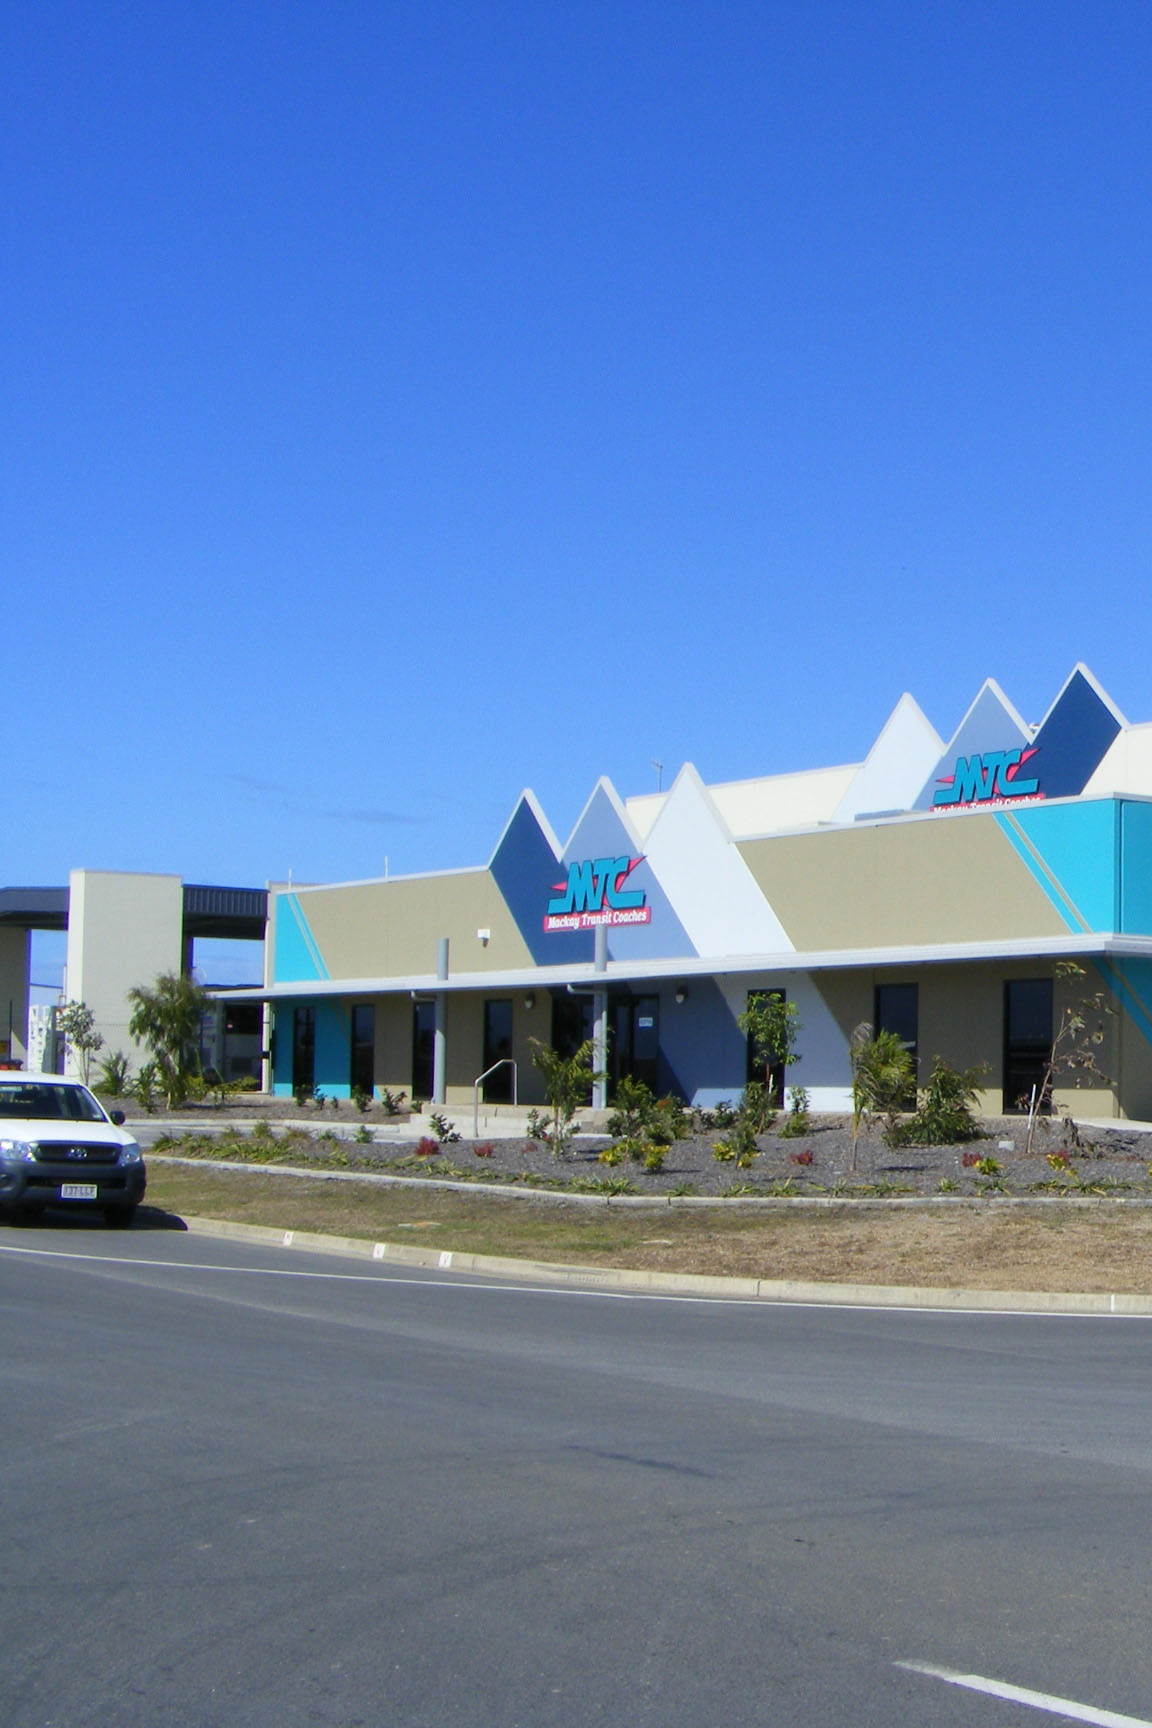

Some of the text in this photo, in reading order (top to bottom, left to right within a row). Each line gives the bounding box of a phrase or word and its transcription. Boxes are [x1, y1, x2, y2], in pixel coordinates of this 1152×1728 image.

[933, 748, 1040, 806] MTC
[547, 856, 647, 915] MTC
[547, 909, 648, 929] Mackay Transit Coaches
